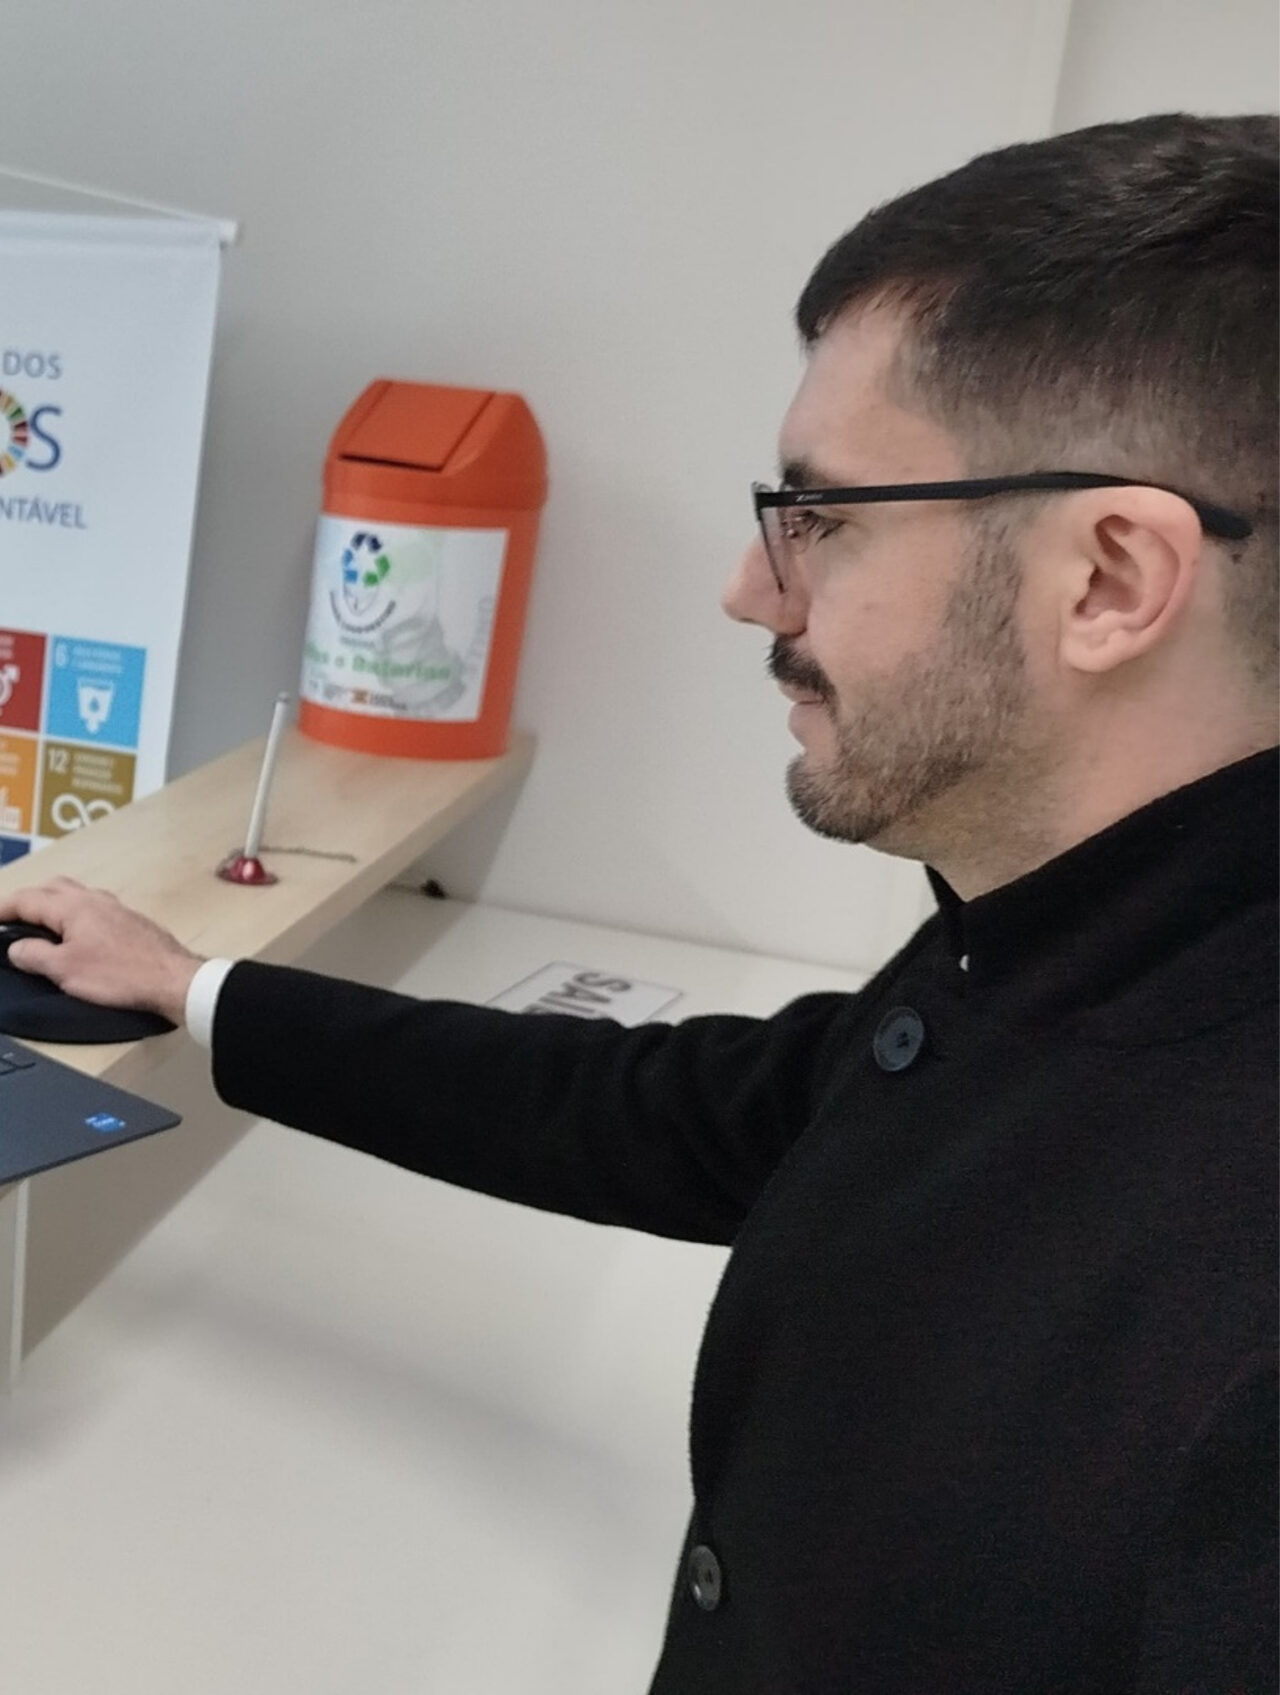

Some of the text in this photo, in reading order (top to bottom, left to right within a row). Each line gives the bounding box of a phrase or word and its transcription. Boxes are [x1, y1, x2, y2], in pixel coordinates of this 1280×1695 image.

[2, 349, 63, 381] DOS
[55, 643, 70, 667] 6
[47, 748, 70, 774] 12
